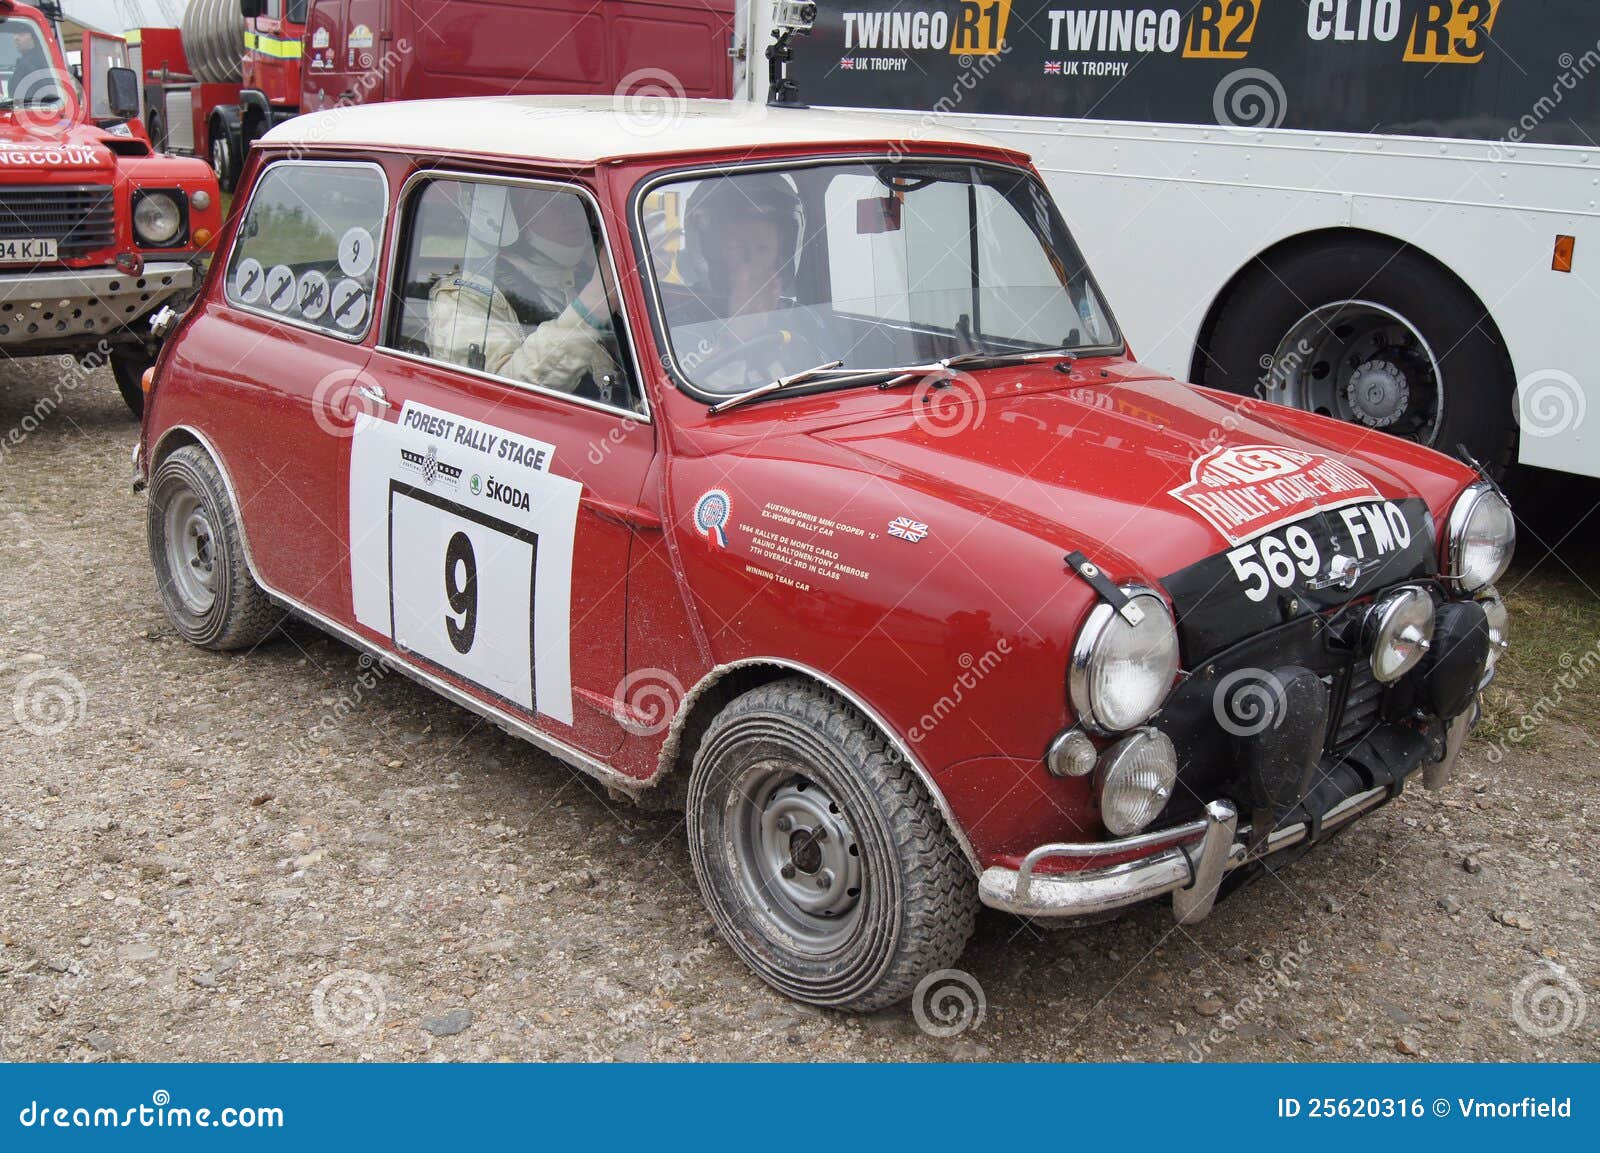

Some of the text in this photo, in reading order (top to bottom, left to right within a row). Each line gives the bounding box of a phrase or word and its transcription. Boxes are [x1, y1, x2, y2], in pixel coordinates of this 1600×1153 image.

[843, 0, 1000, 50] TWINGO R1
[1048, 0, 1254, 52] TWINGO R2
[1307, 0, 1492, 57] CLIO R3
[855, 57, 908, 71] UK TROPHY
[1063, 61, 1128, 76] UK TROPHY
[22, 241, 54, 257] KJL
[352, 240, 360, 263] 9
[404, 408, 546, 471] FOREST RALLY STAGE
[485, 475, 530, 512] ŠKODA
[1187, 459, 1369, 530] RALLYE MONTE-CARLO
[761, 510, 834, 537] EX-WORKS RALLY CAR
[765, 502, 817, 522] AUSTIN/MORRIS
[818, 517, 836, 528] MINI
[836, 523, 865, 537] COOPER
[752, 537, 870, 580] RAUNO AALTONEN/TONY AMBROSE
[754, 528, 779, 541] RALLYE
[779, 536, 789, 544] DE
[789, 539, 814, 552] MONTE
[815, 547, 839, 560] CARLO
[1226, 501, 1411, 602] 569 FMO
[745, 564, 810, 592] WINNING TEAM CAR
[749, 546, 841, 580] 7TH OVERALL 3RD IN CLASS
[445, 531, 478, 655] 9
